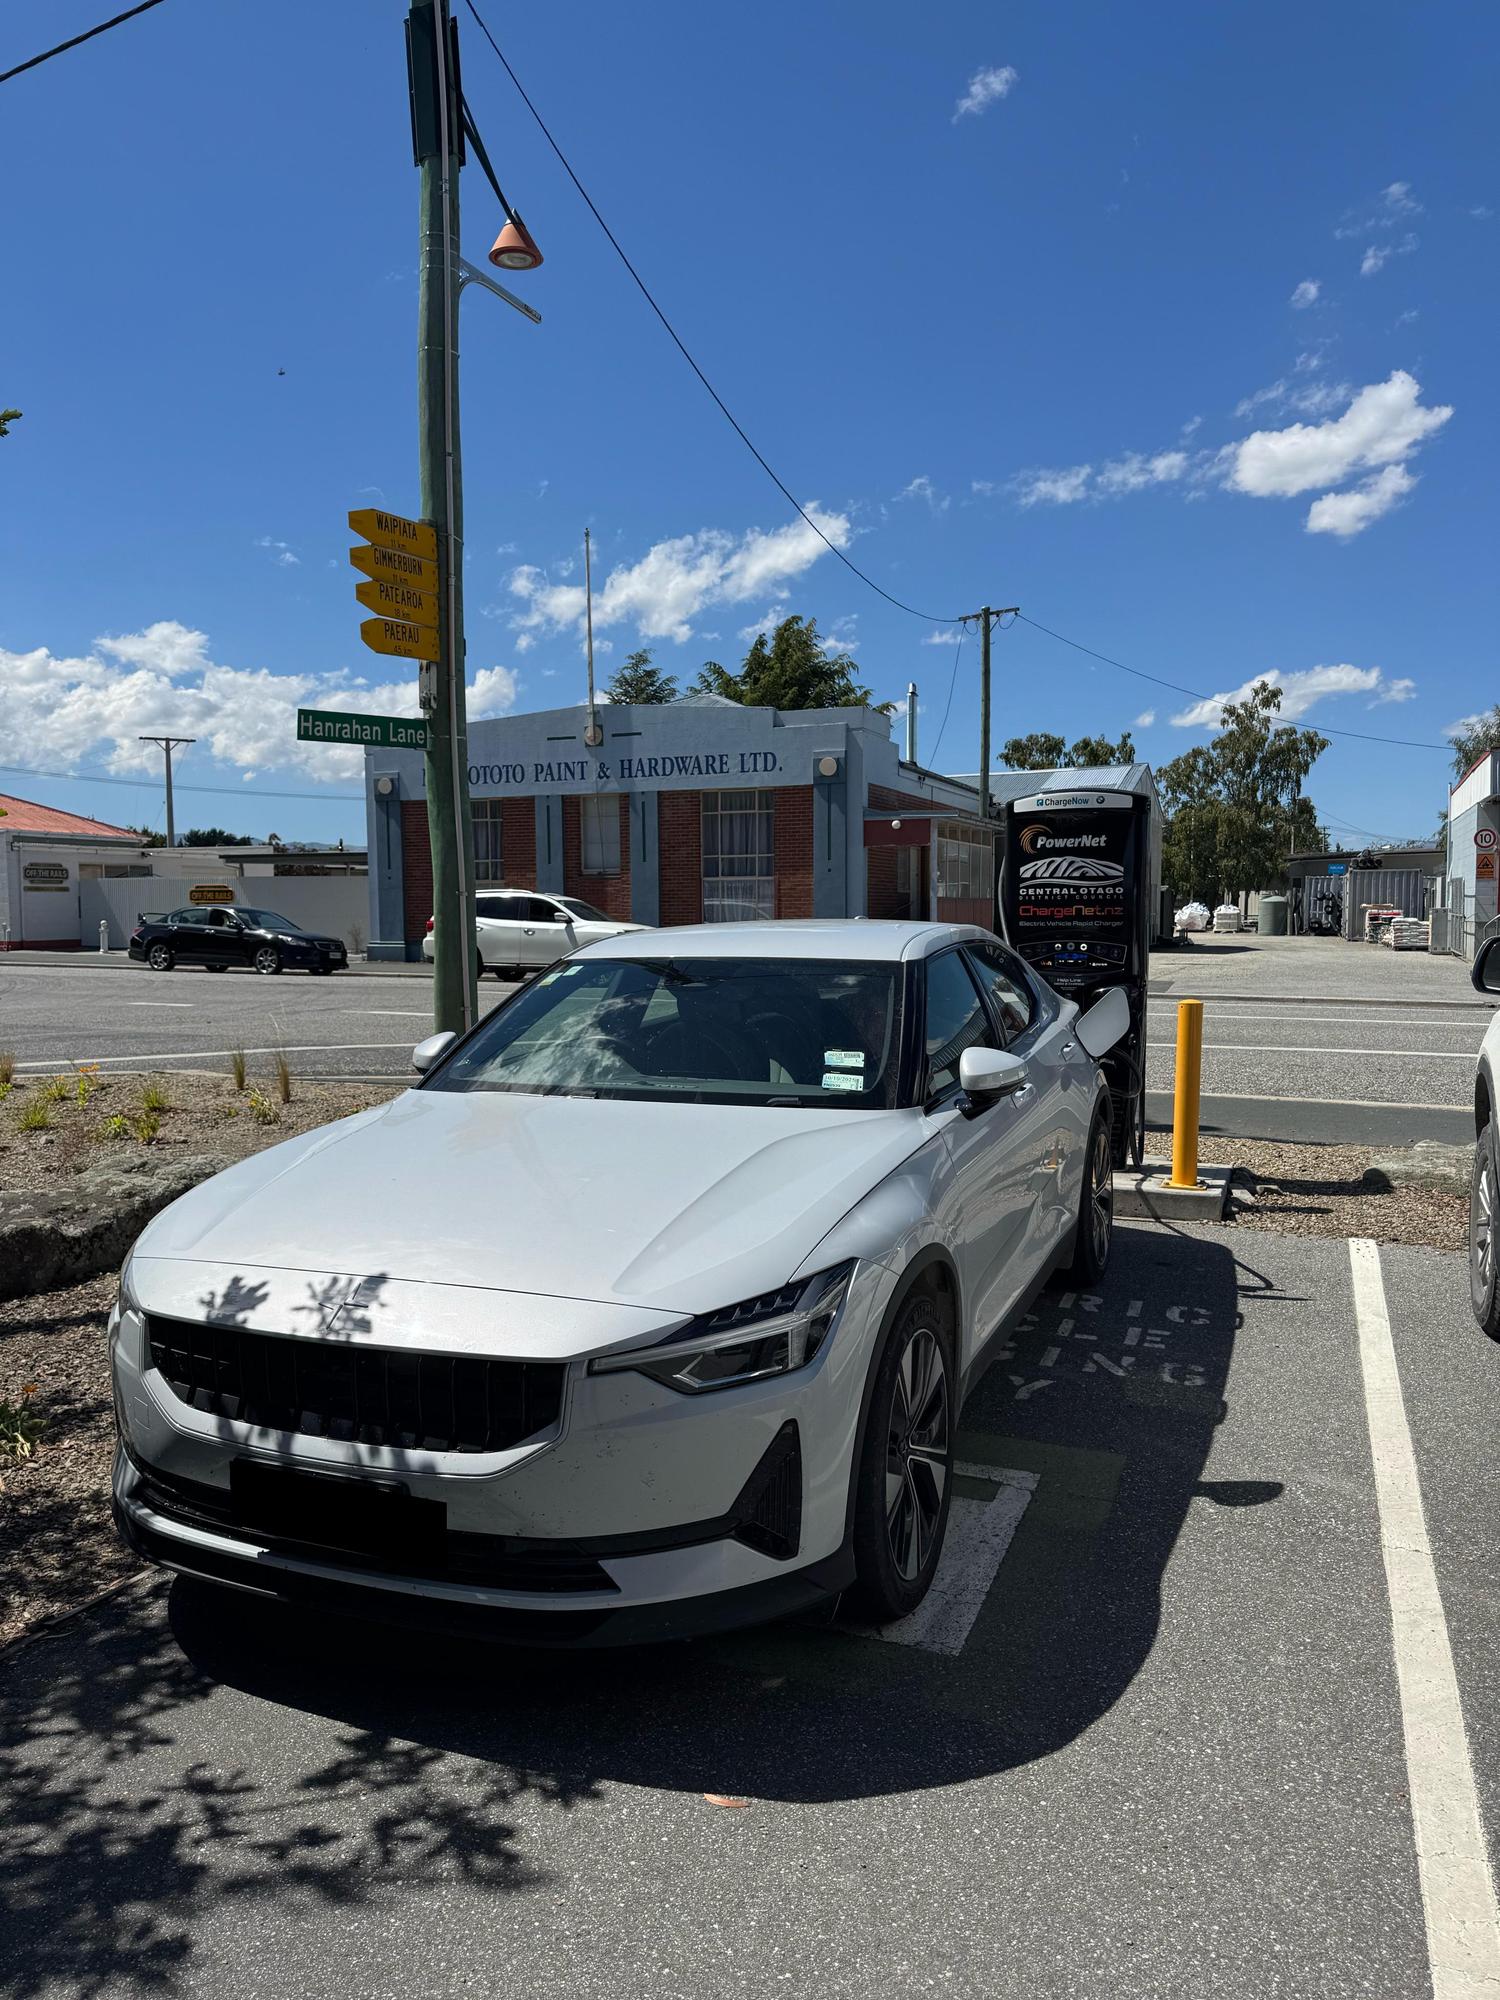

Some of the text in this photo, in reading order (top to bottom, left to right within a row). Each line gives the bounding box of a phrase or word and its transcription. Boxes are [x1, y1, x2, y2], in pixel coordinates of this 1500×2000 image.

[376, 512, 418, 541] WAIPIATA
[373, 547, 423, 577] GIMMERBURN
[379, 583, 423, 610] PATEAROA
[384, 622, 420, 644] PAERAU
[299, 714, 425, 745] Hanrahan Lane
[534, 760, 588, 783] PAINT
[597, 761, 611, 780] &
[619, 753, 730, 779] HARDWARE
[739, 751, 783, 774] LTD.
[1044, 796, 1090, 807] ChargeNow
[1036, 833, 1108, 849] PowerNet
[1479, 832, 1492, 844] 10
[1019, 886, 1124, 896] CENTRAL OTAGO
[1019, 904, 1124, 918] ChargeNet.nz
[1072, 920, 1094, 928] Rapid
